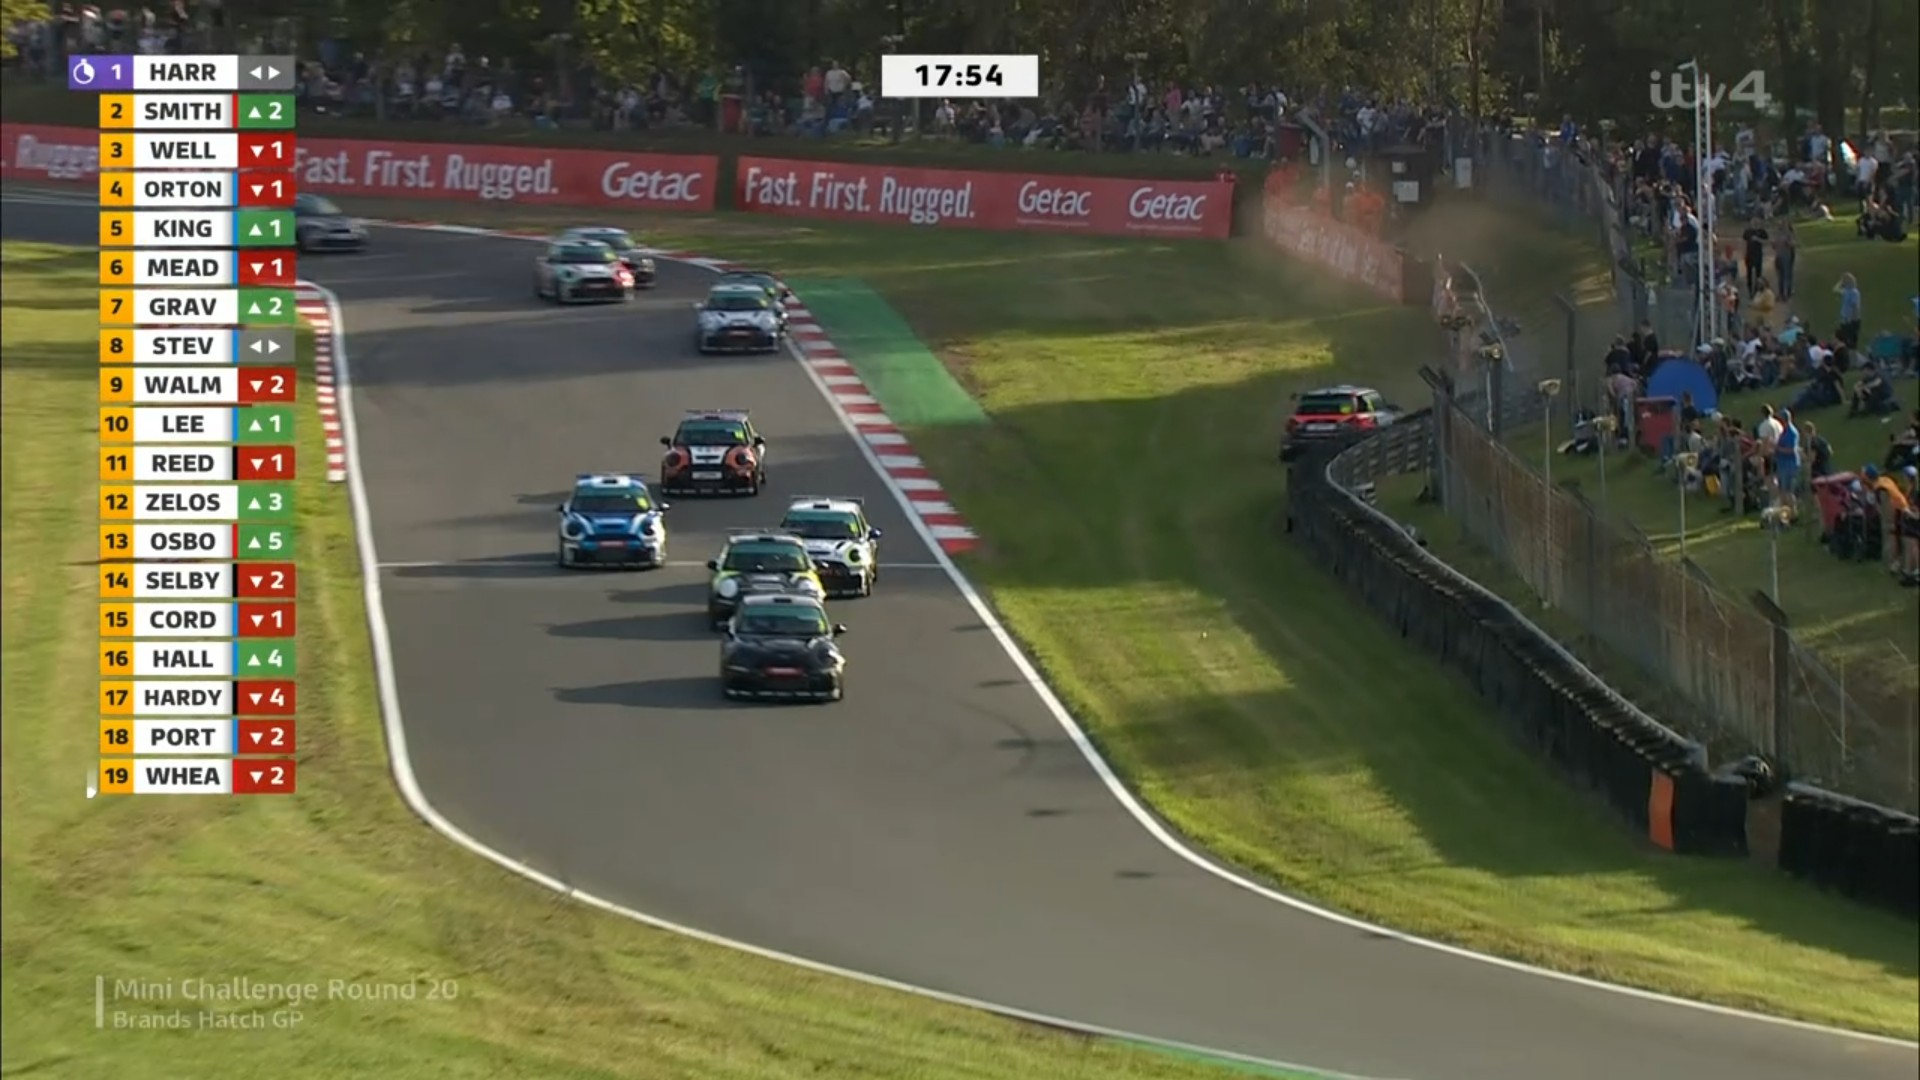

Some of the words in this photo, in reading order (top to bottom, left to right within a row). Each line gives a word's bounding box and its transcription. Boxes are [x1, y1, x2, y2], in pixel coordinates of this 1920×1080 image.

[364, 151, 434, 188] First.
[444, 154, 559, 199] Rugged.
[602, 161, 702, 201] Getac
[745, 167, 800, 206] Fast.
[809, 172, 870, 212] First.
[879, 177, 975, 224] Rugged.
[1018, 181, 1092, 216] Getac
[1129, 187, 1206, 220] Getac
